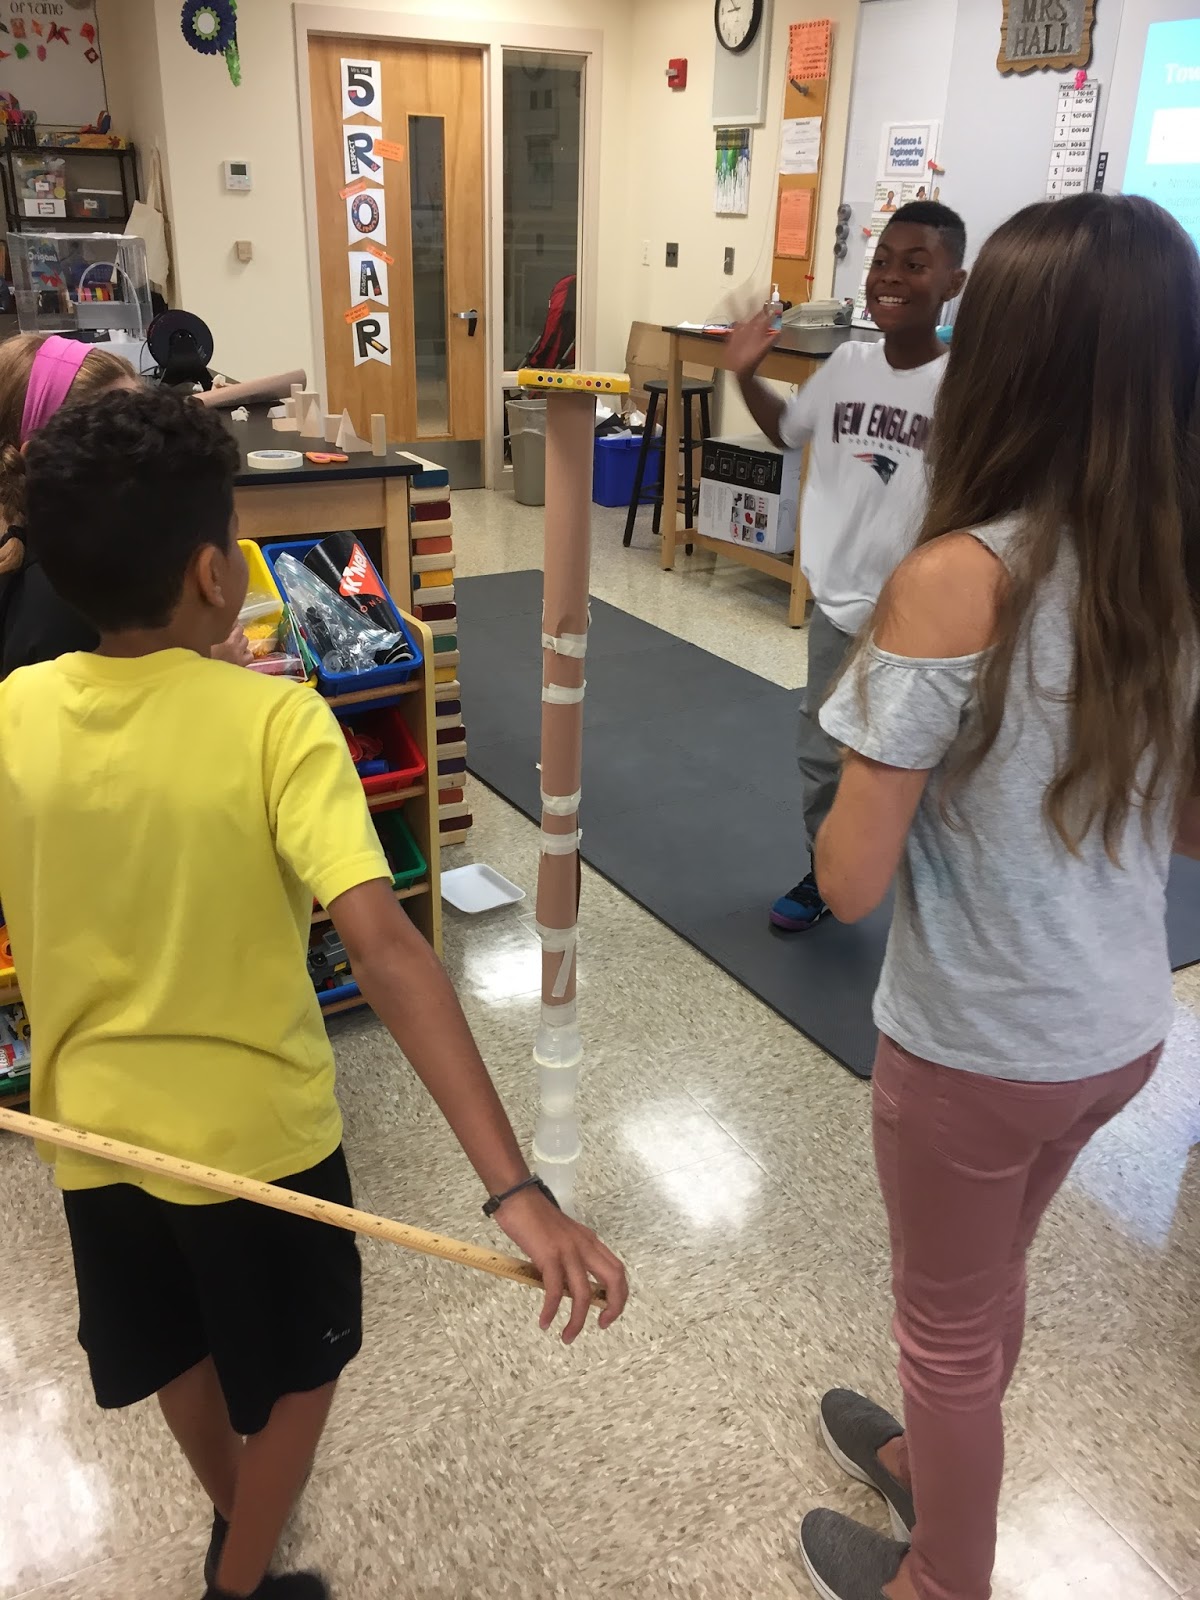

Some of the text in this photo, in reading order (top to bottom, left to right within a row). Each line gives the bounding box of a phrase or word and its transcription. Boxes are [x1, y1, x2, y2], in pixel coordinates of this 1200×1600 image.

[1021, 0, 1068, 23] MRS
[1012, 23, 1072, 57] HALL
[1061, 114, 1066, 122] 2
[347, 132, 381, 174] R
[890, 147, 924, 157] Engineering
[894, 136, 917, 145] Science
[349, 140, 358, 171] RESPECT
[892, 158, 919, 167] Practices
[28, 251, 58, 263] Origami
[360, 260, 382, 296] A
[356, 319, 388, 357] R
[832, 402, 930, 450] NEW ENGLAN
